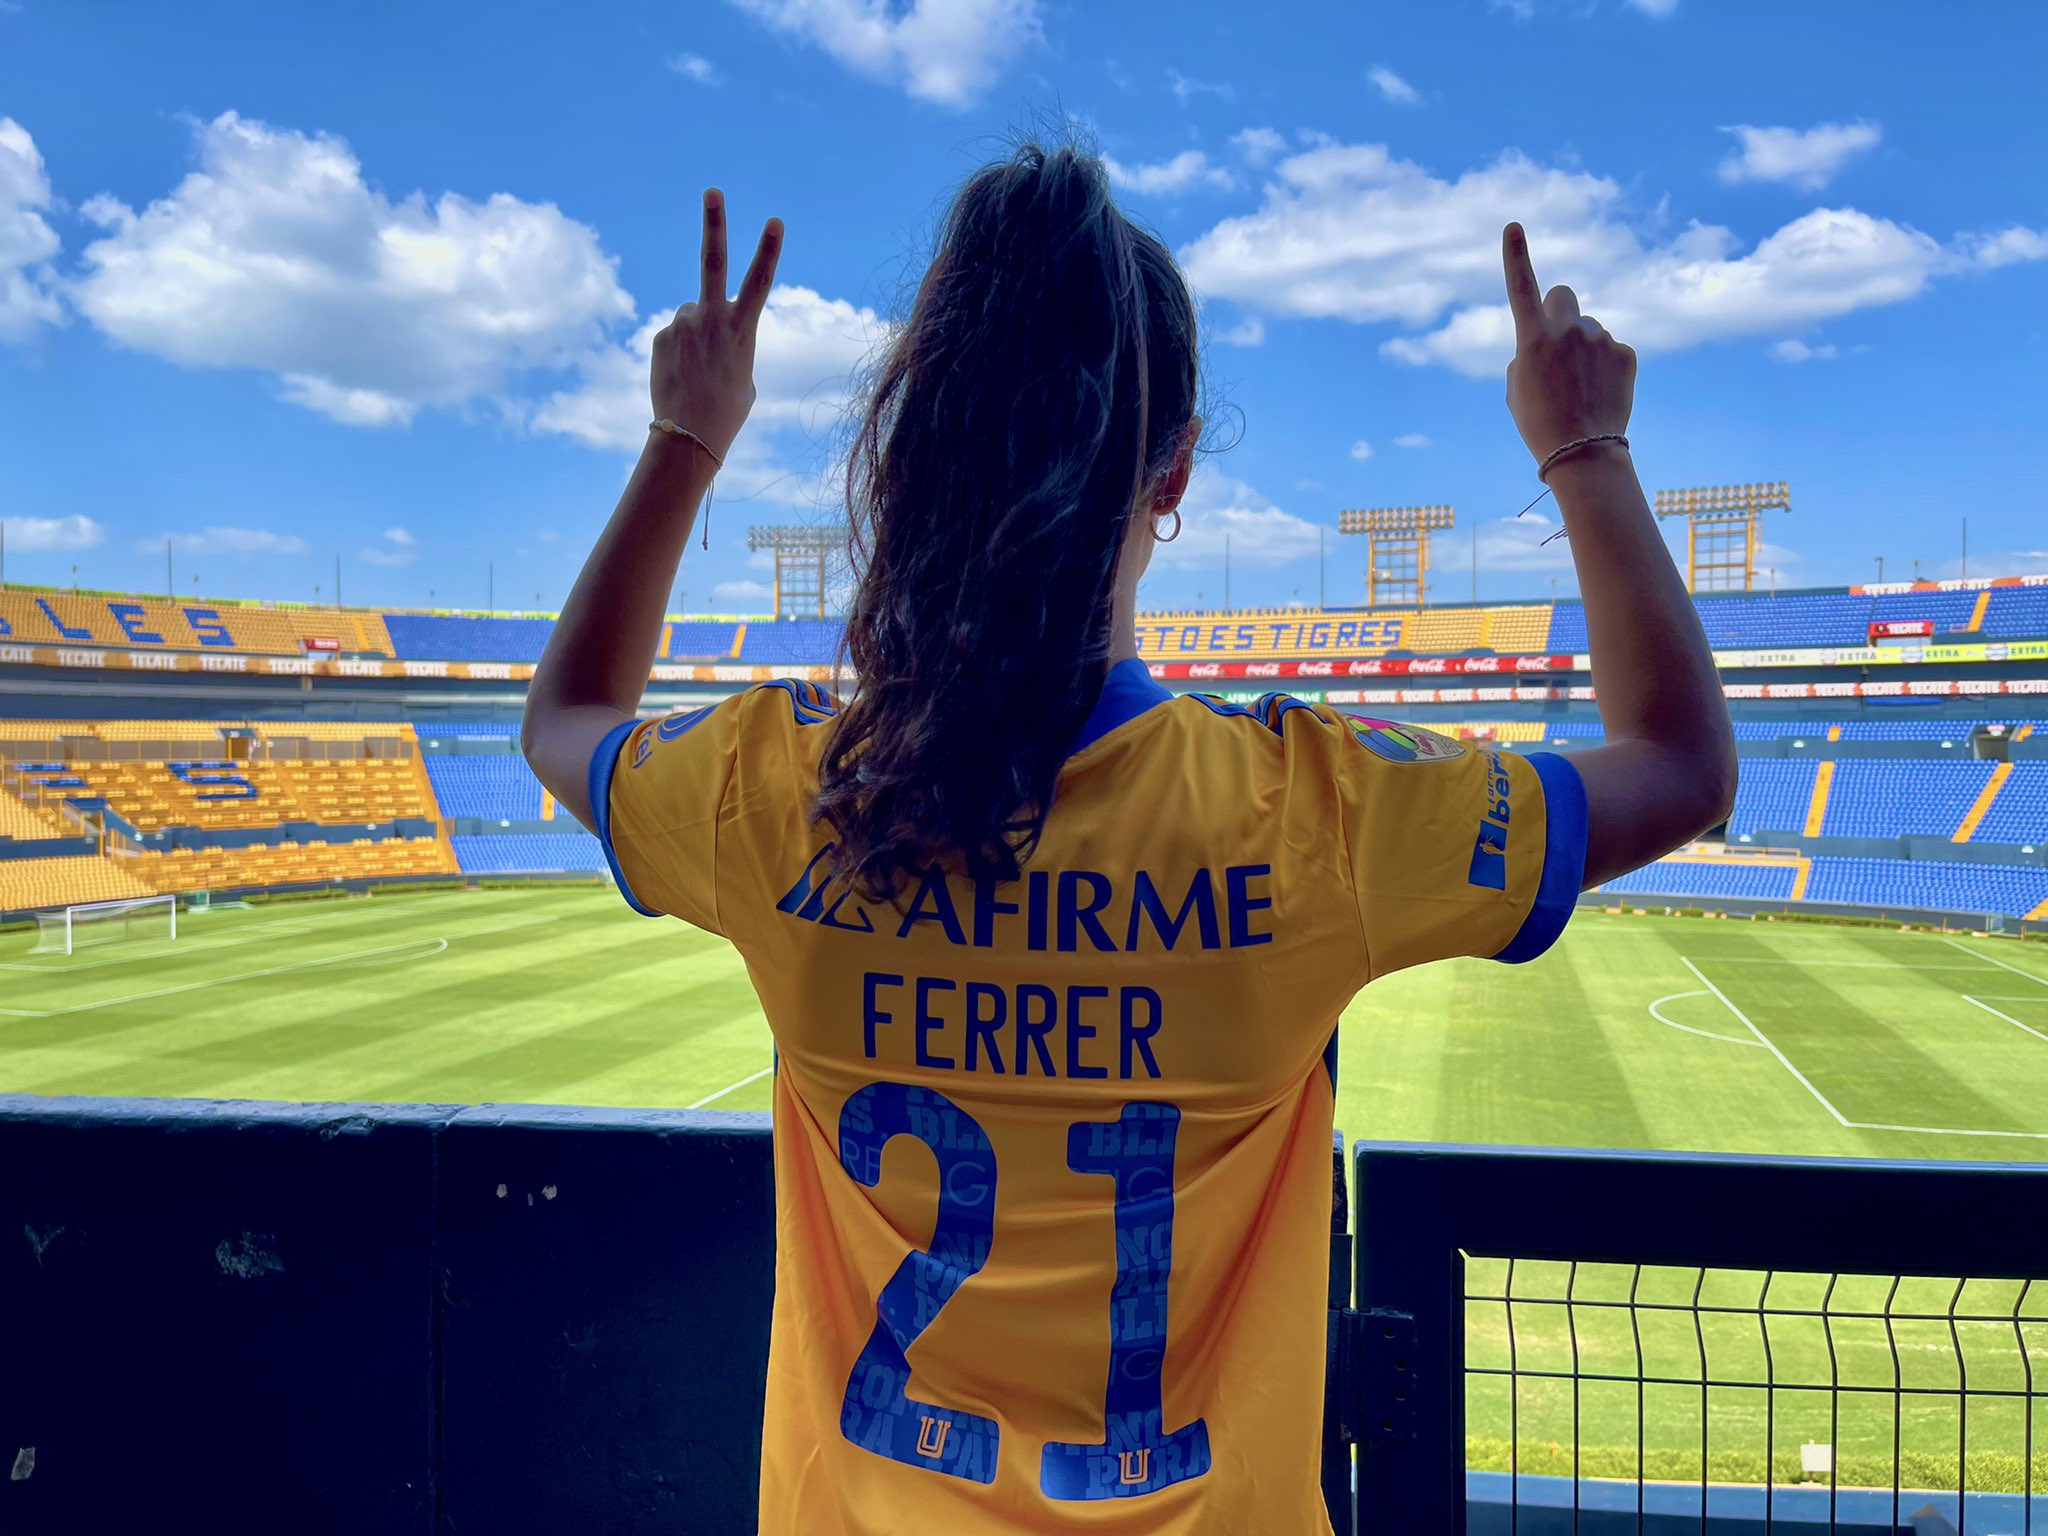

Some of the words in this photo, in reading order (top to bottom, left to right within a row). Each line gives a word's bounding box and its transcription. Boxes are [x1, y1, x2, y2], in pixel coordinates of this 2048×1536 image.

[1269, 620, 1403, 649] TIGRES
[1760, 653, 1796, 662] EXTRA
[1839, 651, 1877, 660] EXTRA
[1926, 649, 1960, 658] EXTRA
[2011, 646, 2045, 656] EXTRA
[57, 651, 105, 667] TECATE
[129, 652, 178, 669] TECATE
[200, 654, 248, 671] TECATE
[267, 657, 315, 674] TECATE
[337, 660, 383, 676] TECATE
[403, 661, 448, 676] TECATE
[467, 663, 512, 679] TECATE
[896, 861, 1273, 952] AFIRME
[863, 972, 1163, 1080] FERRER
[838, 1081, 1214, 1500] 21
